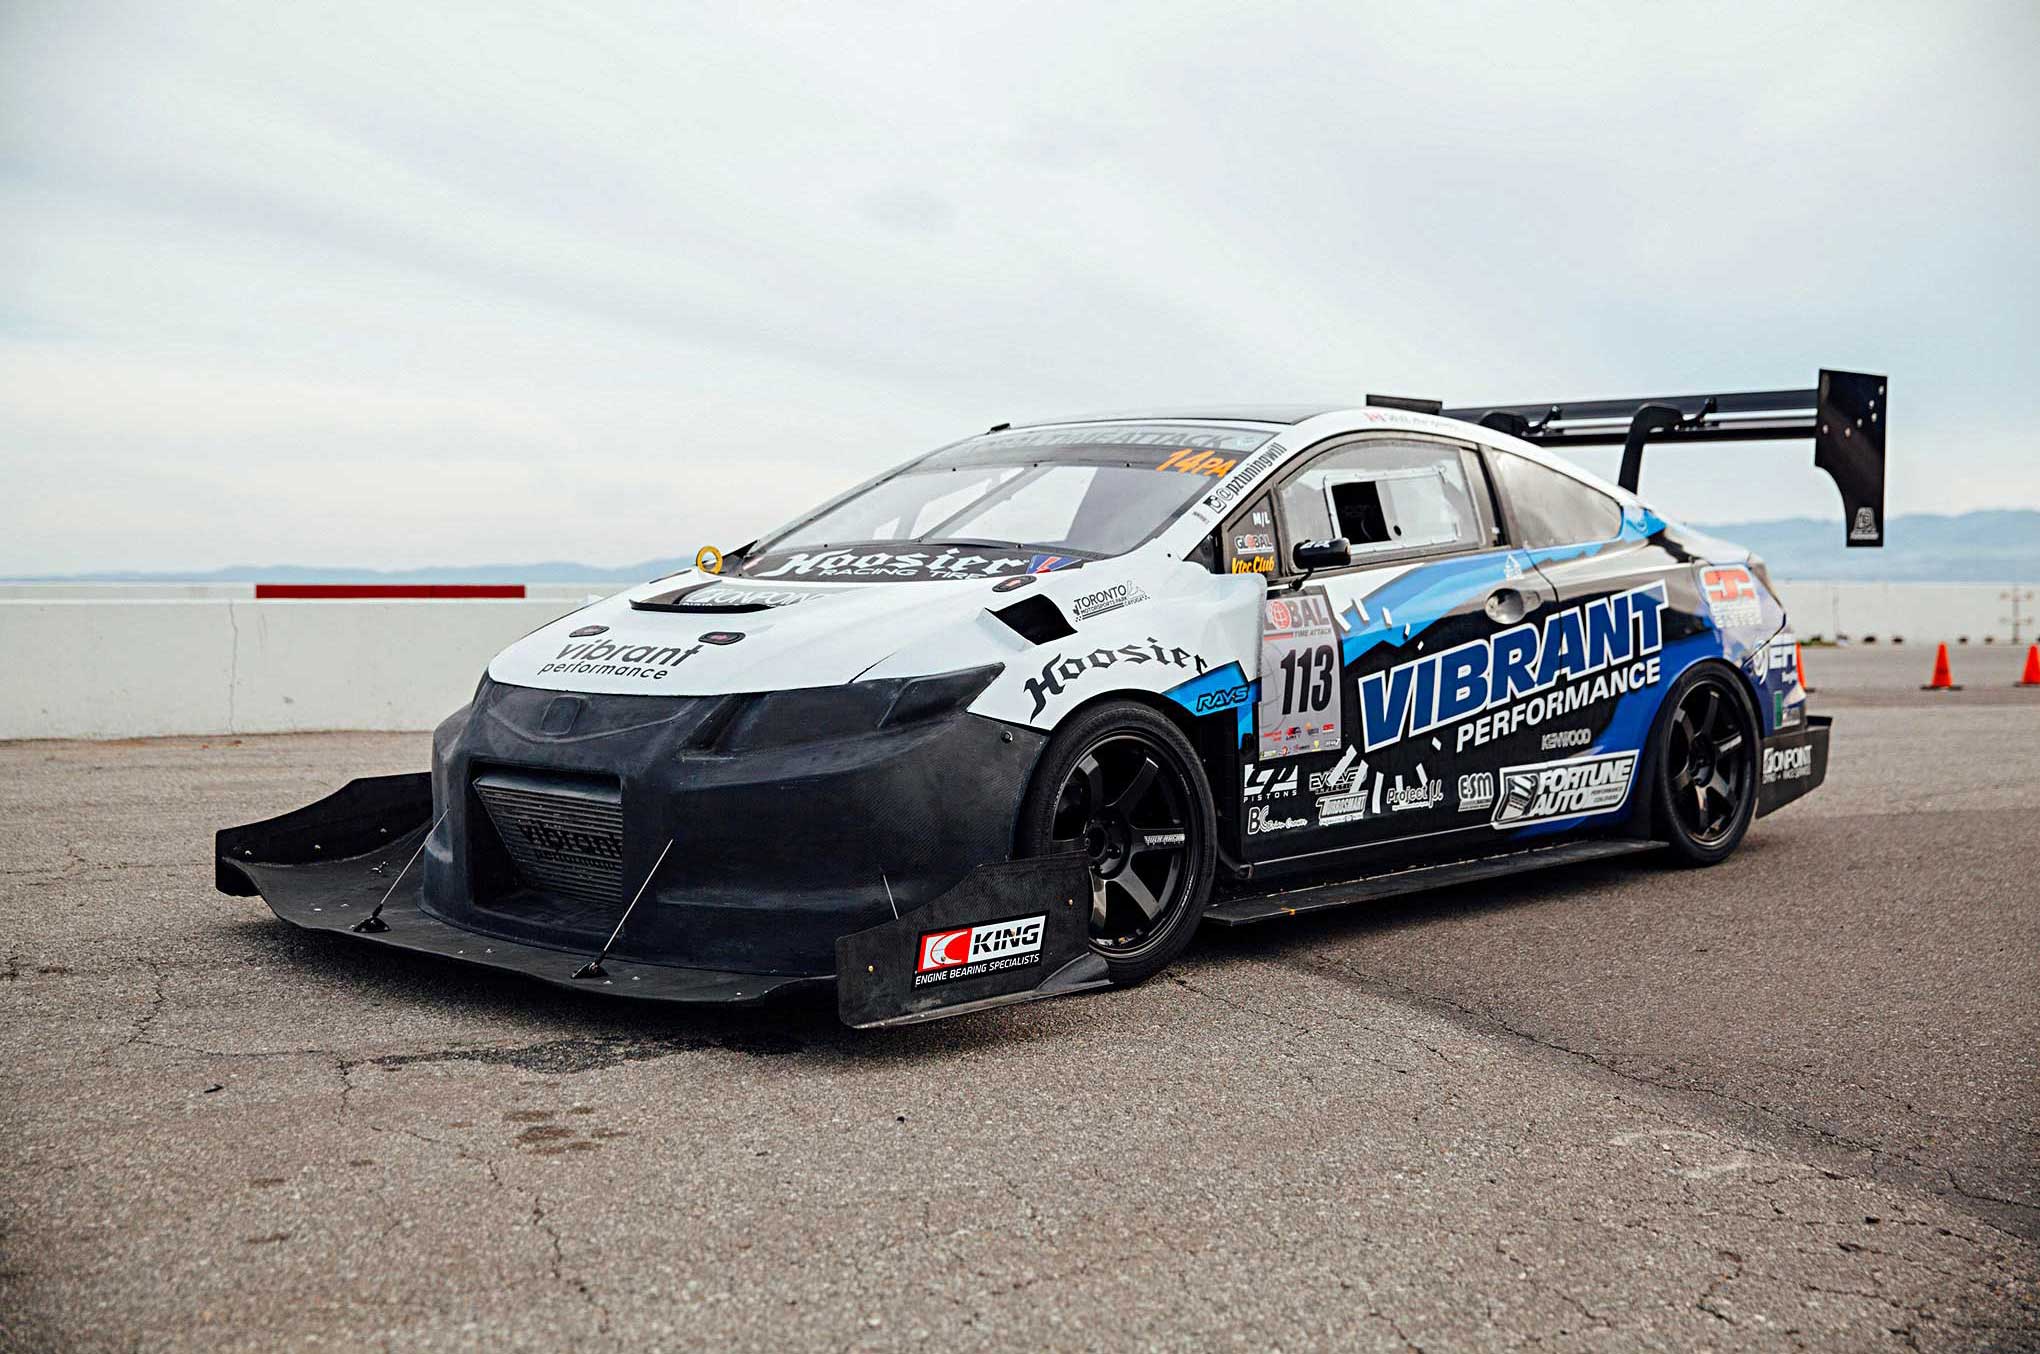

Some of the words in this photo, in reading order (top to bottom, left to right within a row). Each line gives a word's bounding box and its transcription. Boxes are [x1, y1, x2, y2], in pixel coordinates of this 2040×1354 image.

[754, 548, 1027, 576] Hoosier
[818, 567, 919, 577] RACING
[1253, 556, 1275, 572] Club
[1073, 584, 1127, 610] TORONTO
[553, 639, 704, 668] vibrant
[1358, 579, 1670, 753] VIBRANT
[537, 659, 669, 680] performance
[1023, 636, 1208, 724] Hoosier
[1280, 644, 1334, 715] 113
[1196, 685, 1249, 712] RAYS
[1456, 657, 1662, 753] PERFORMANCE
[1541, 728, 1592, 751] KENWOOD
[1538, 758, 1634, 795] FORTUNE
[1243, 789, 1297, 803] PISTONS
[1387, 785, 1428, 805] Project
[1531, 788, 1587, 817] AUTO
[973, 923, 1040, 955] KING
[915, 970, 948, 986] ENGINE
[949, 965, 987, 979] BEARING
[989, 953, 1040, 971] SPECIALISTS
